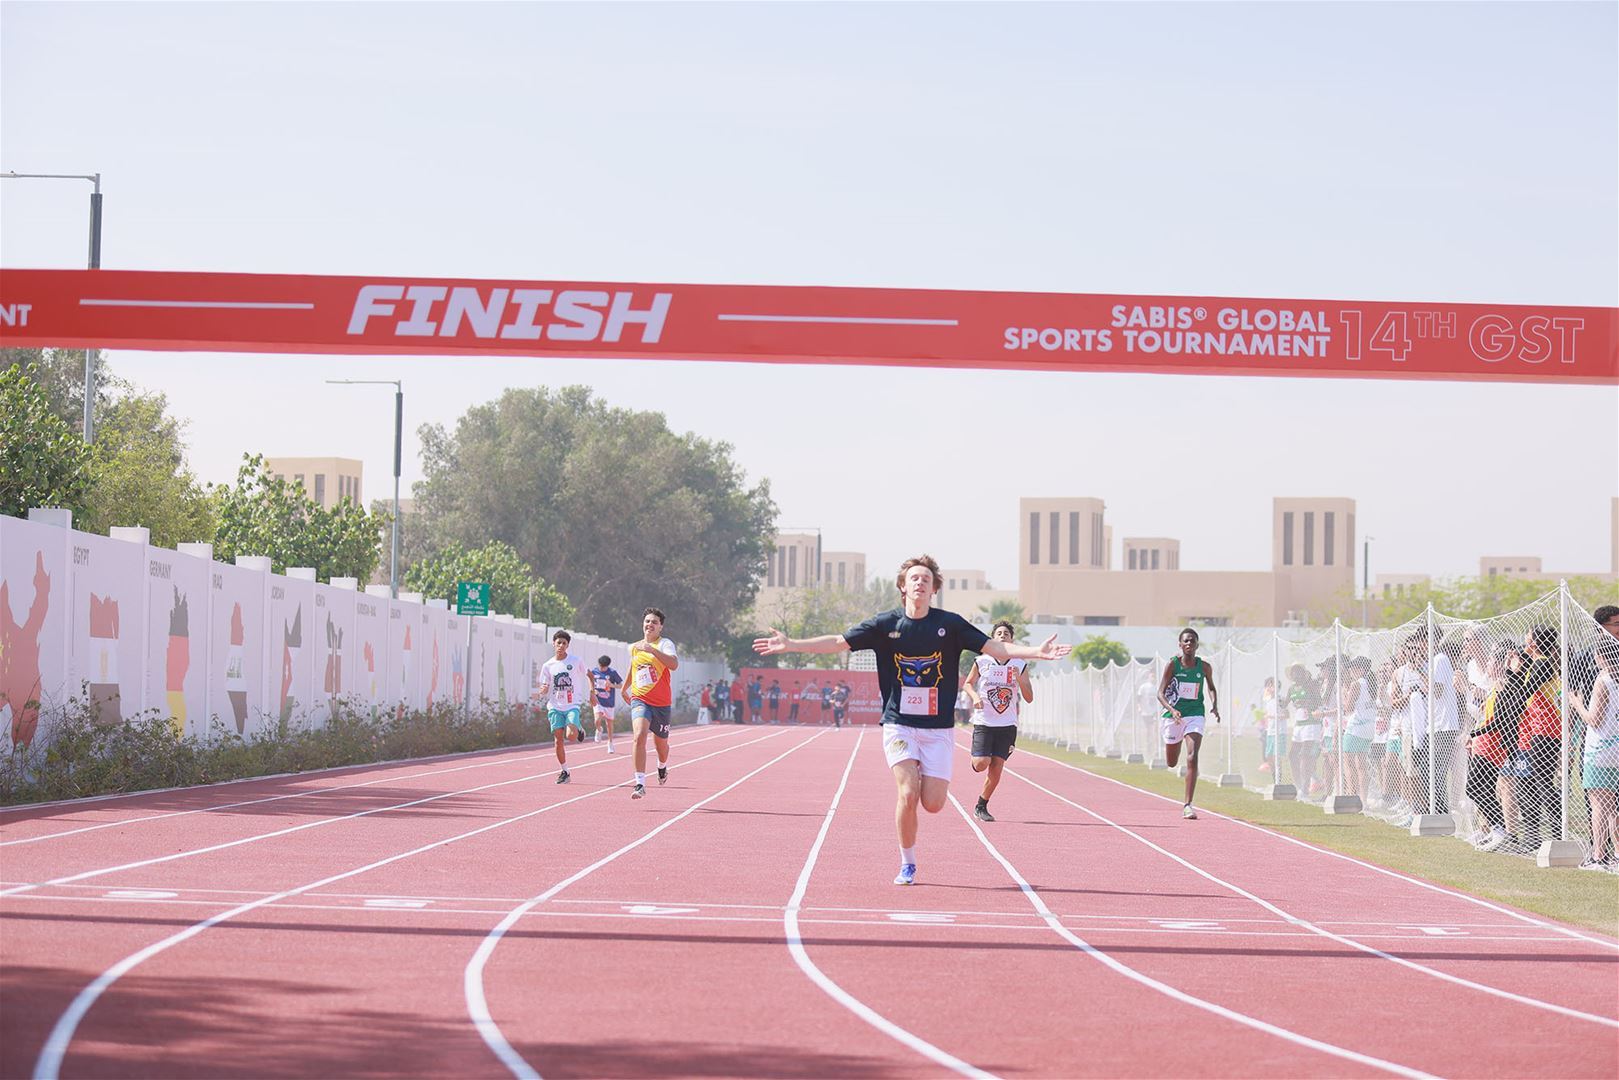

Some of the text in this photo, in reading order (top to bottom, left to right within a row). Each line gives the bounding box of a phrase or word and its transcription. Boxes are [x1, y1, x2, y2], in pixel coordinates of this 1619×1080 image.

[347, 284, 673, 344] FINISH
[1217, 308, 1331, 333] GLOBAL
[1004, 327, 1331, 358] SPORTS TOURNAMENT
[1340, 310, 1585, 364] 14TH GST
[73, 546, 90, 567] EGYPT
[149, 560, 173, 579] GERMANY
[907, 696, 923, 705] 223
[621, 904, 701, 915] 4
[1148, 920, 1227, 930] 2
[1397, 926, 1471, 936] 1
